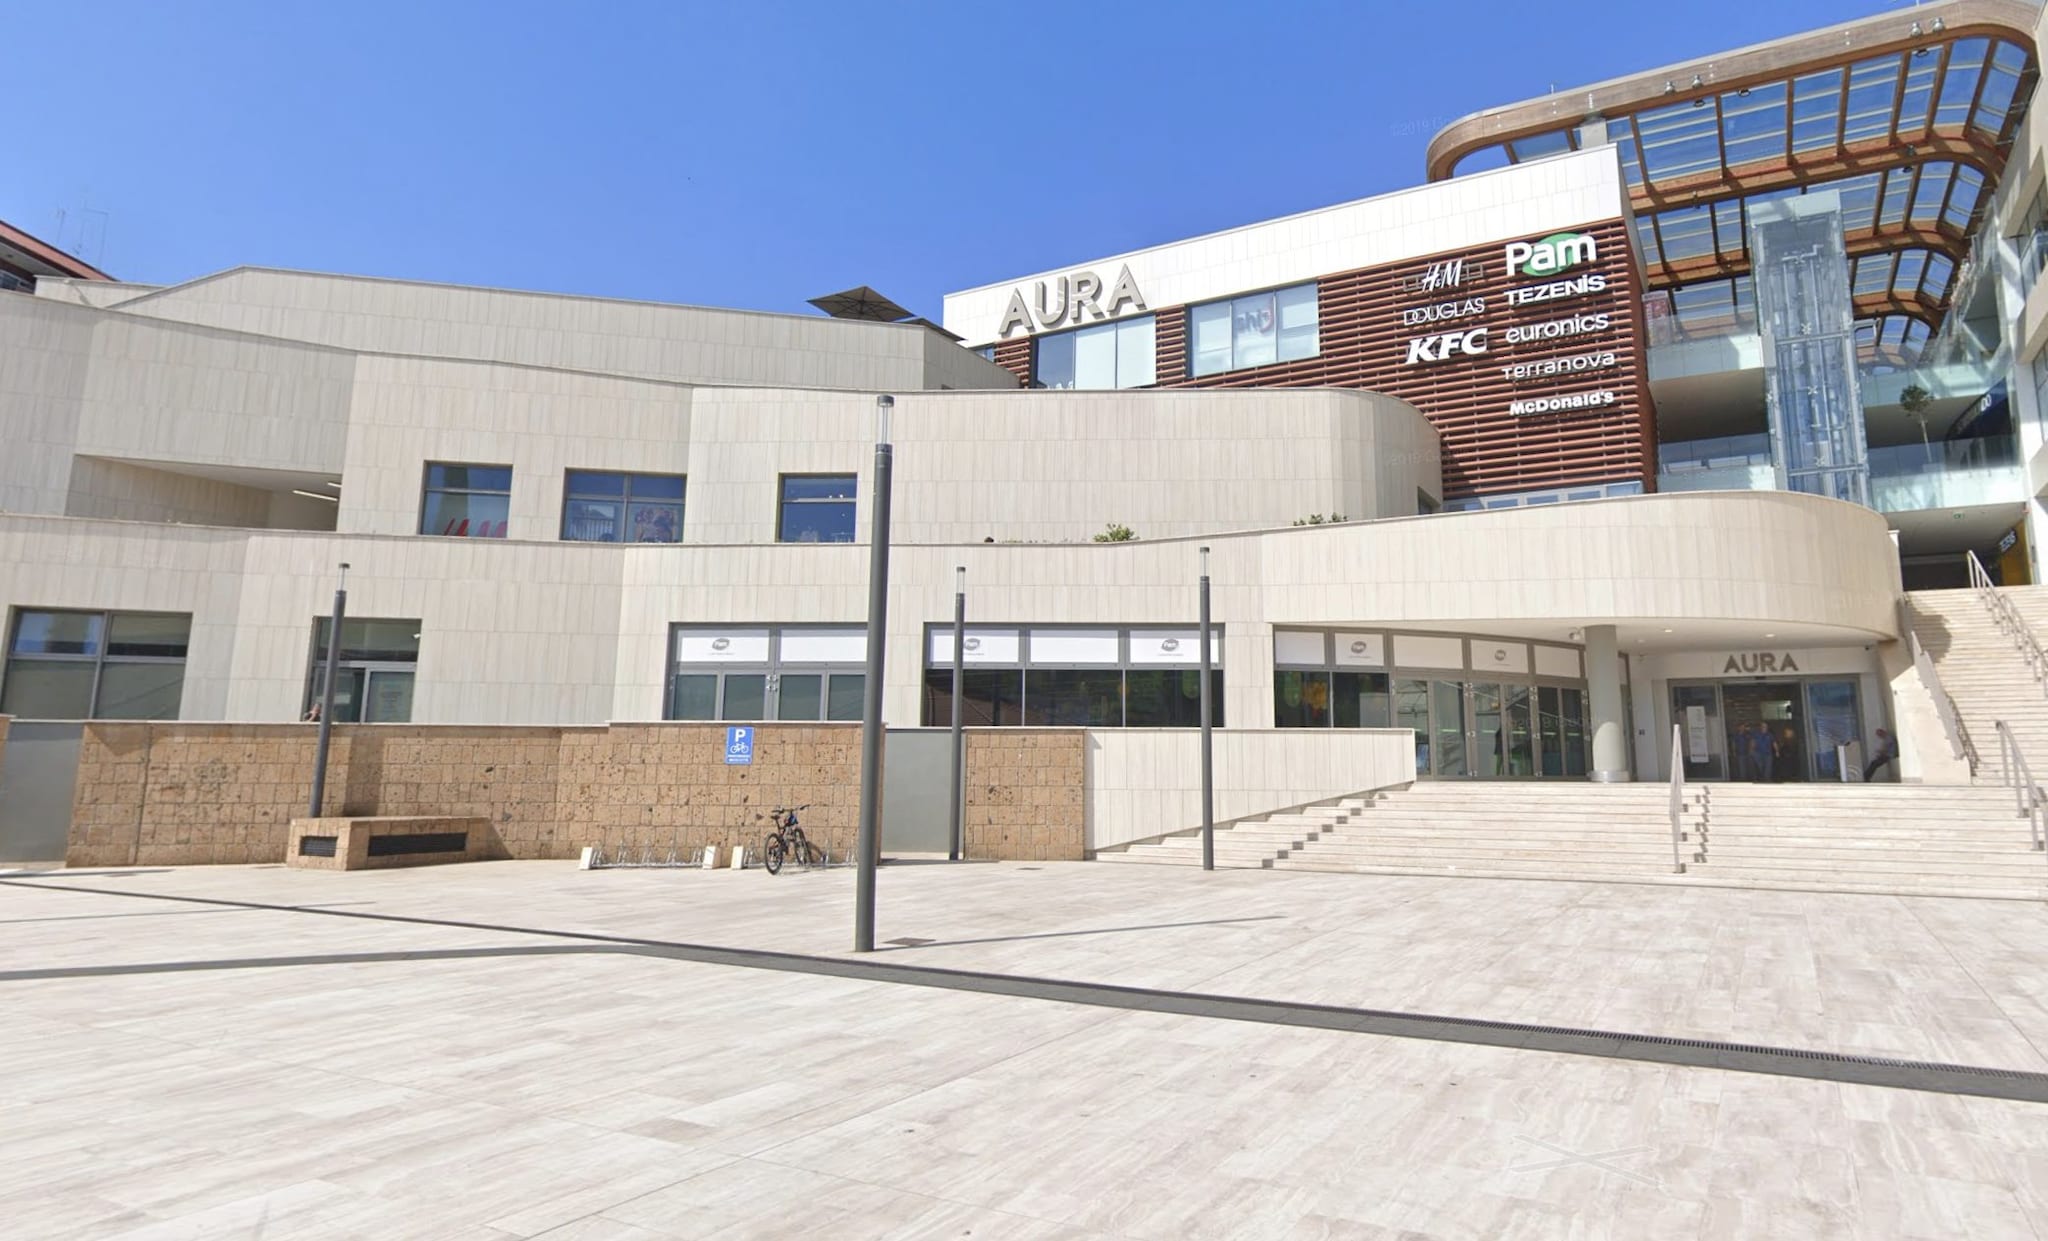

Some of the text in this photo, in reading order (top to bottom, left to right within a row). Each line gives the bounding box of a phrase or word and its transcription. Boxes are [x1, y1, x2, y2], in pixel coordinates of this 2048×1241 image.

[1505, 235, 1597, 276] Pam
[1421, 259, 1462, 292] H&M
[999, 263, 1148, 338] AURA
[1404, 298, 1485, 326] DOUGLAS
[1505, 313, 1609, 343] euronics
[1404, 328, 1488, 365] KFC
[1509, 391, 1615, 416] McDonald's
[1723, 653, 1799, 674] AURA
[735, 728, 746, 743] P
